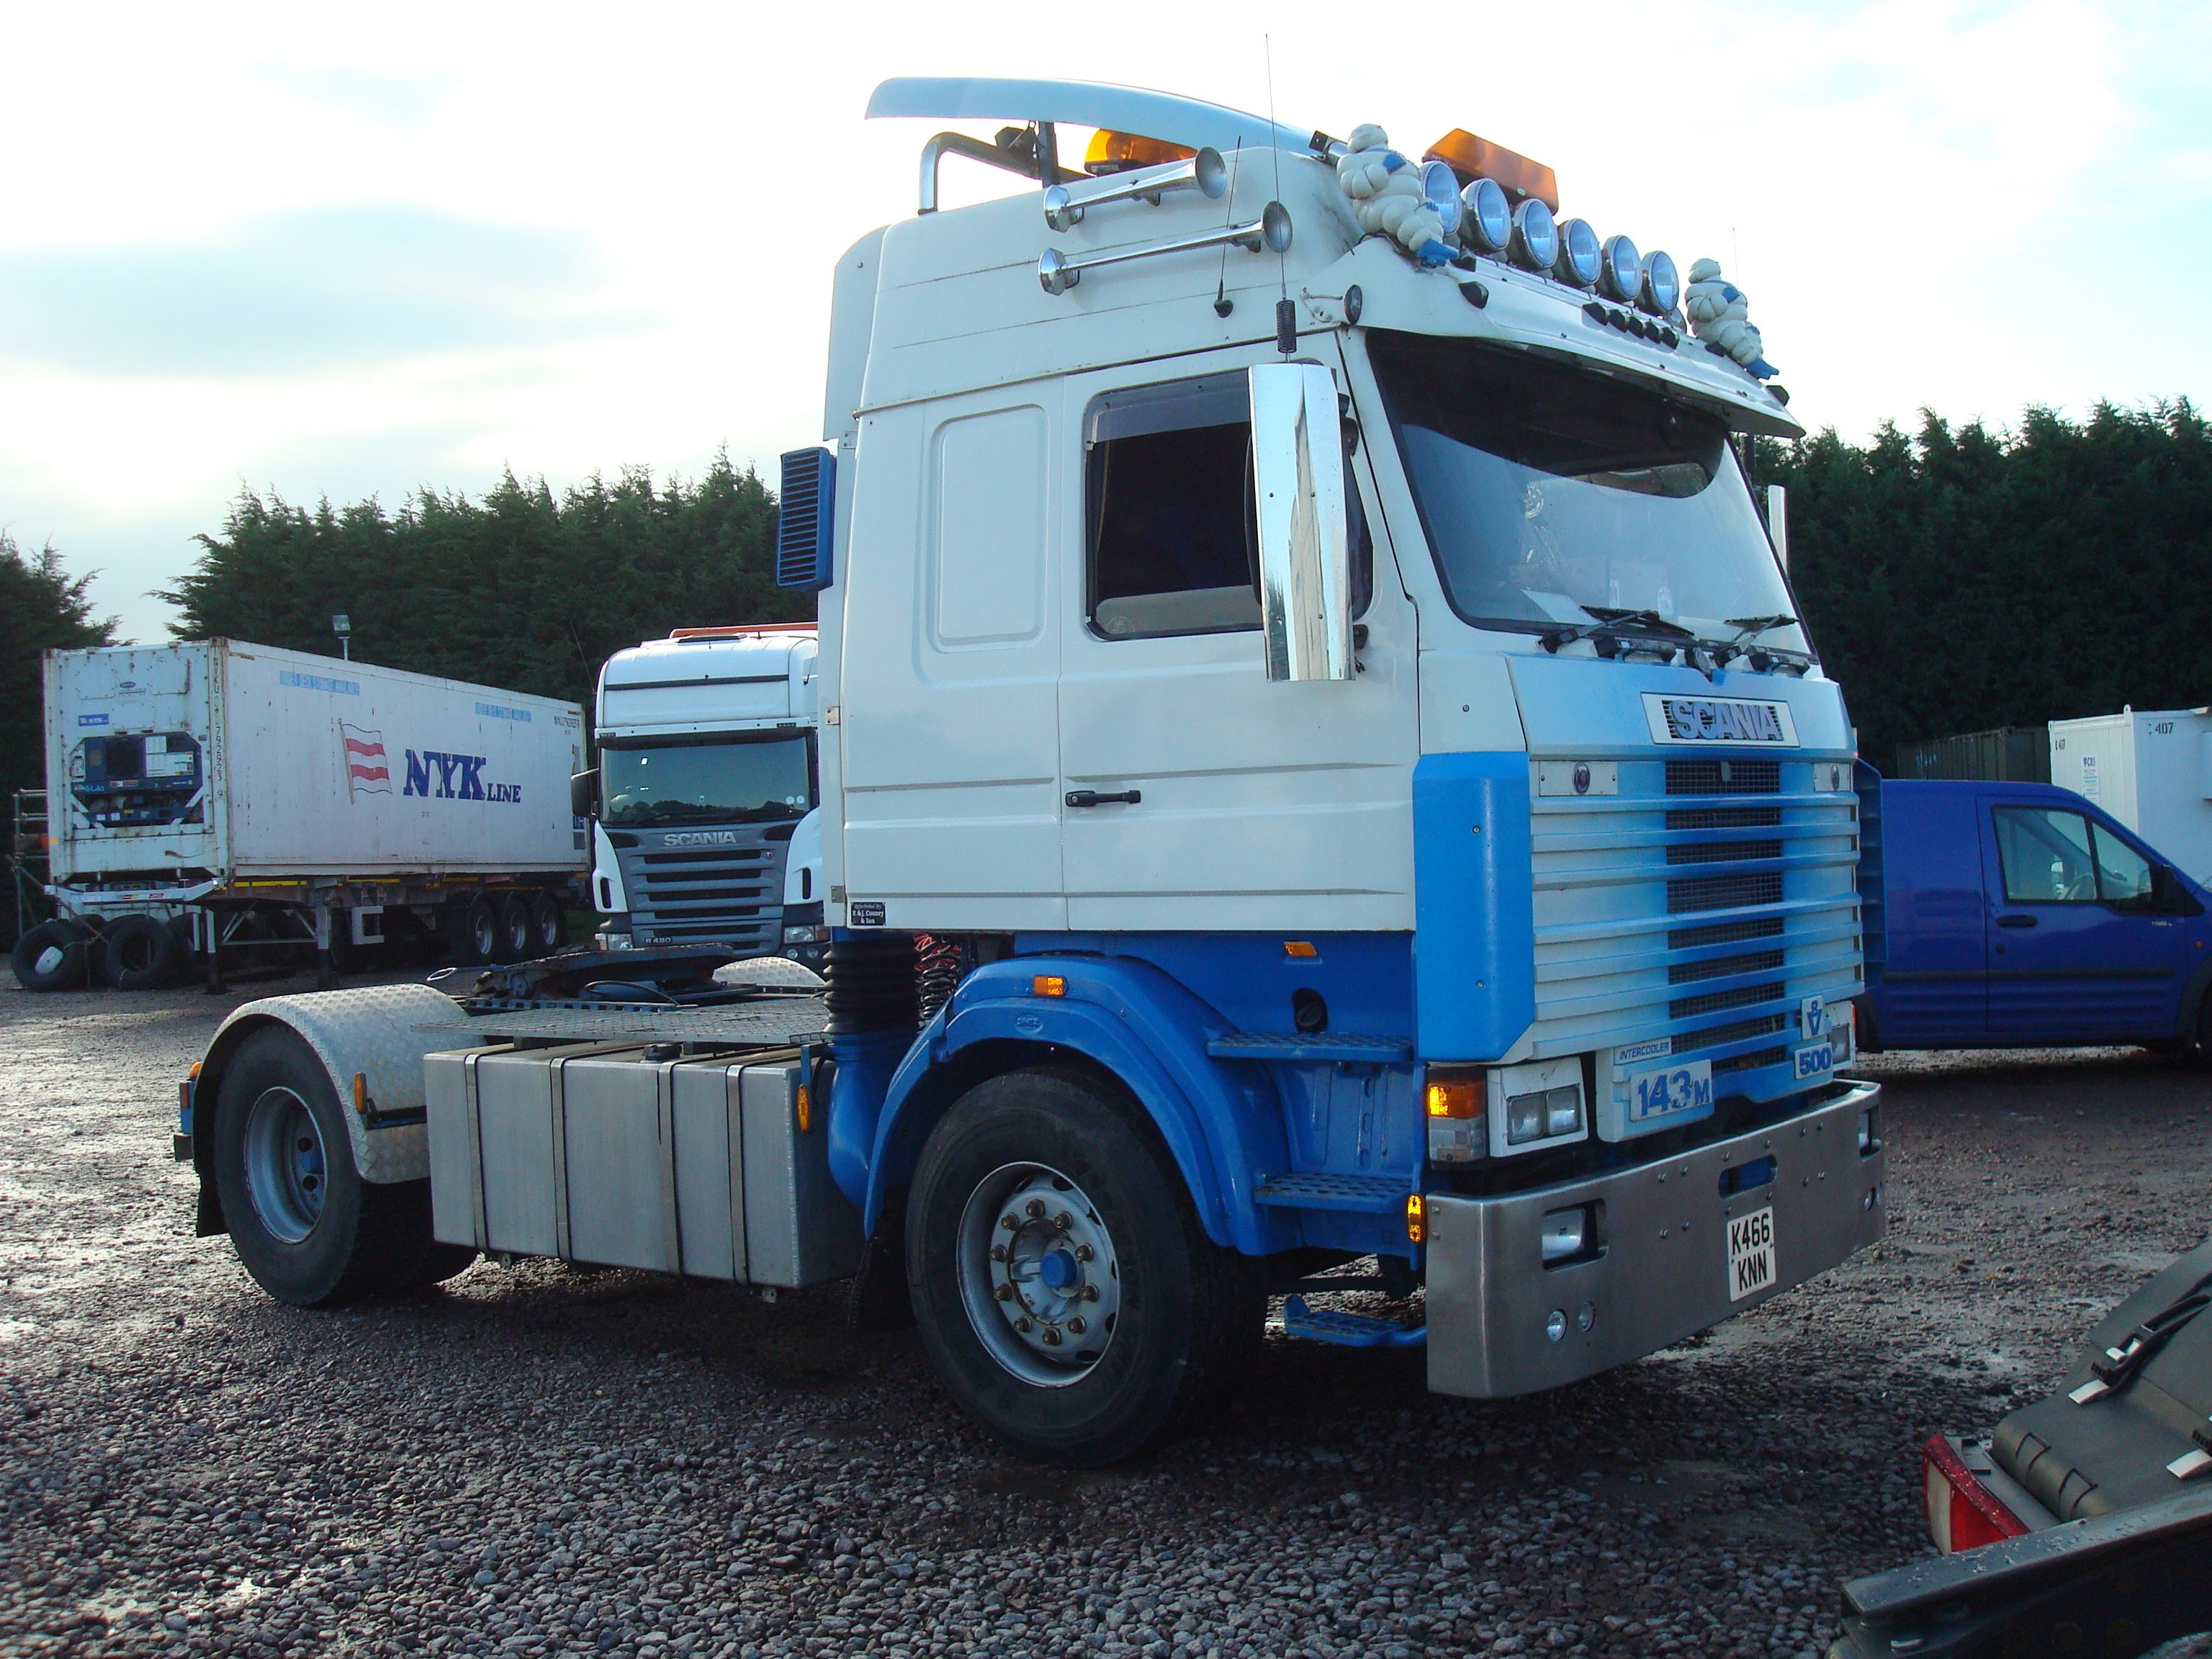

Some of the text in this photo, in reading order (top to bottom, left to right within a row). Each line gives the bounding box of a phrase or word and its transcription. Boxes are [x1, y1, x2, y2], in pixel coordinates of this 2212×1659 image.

[1671, 700, 1784, 740] SCANIA
[2155, 722, 2175, 734] 407
[403, 749, 521, 803] NYK LINE
[664, 831, 737, 847] SCANIA
[1619, 1041, 1670, 1061] INTERCOOLER
[1799, 1048, 1832, 1076] 500
[1732, 1213, 1770, 1256] K466
[1738, 1250, 1767, 1292] KNN
